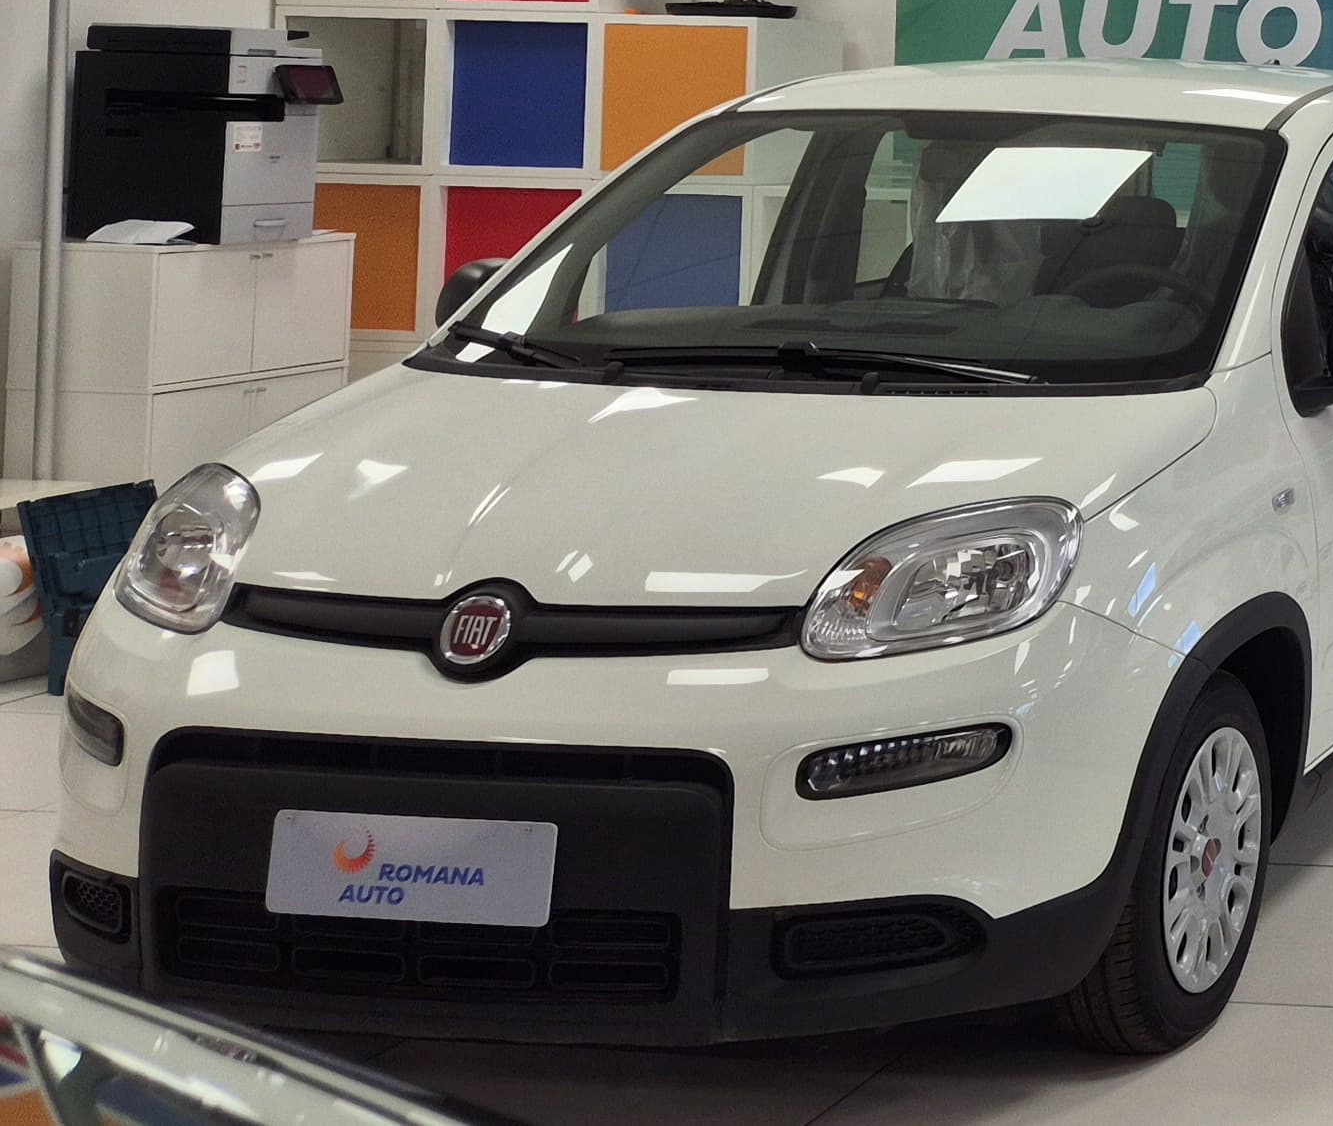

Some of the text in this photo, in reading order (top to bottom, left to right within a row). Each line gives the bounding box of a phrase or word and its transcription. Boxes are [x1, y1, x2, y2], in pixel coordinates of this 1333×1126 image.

[453, 614, 498, 646] FIAT
[378, 863, 485, 886] ROMANA
[338, 884, 405, 905] AUTO
